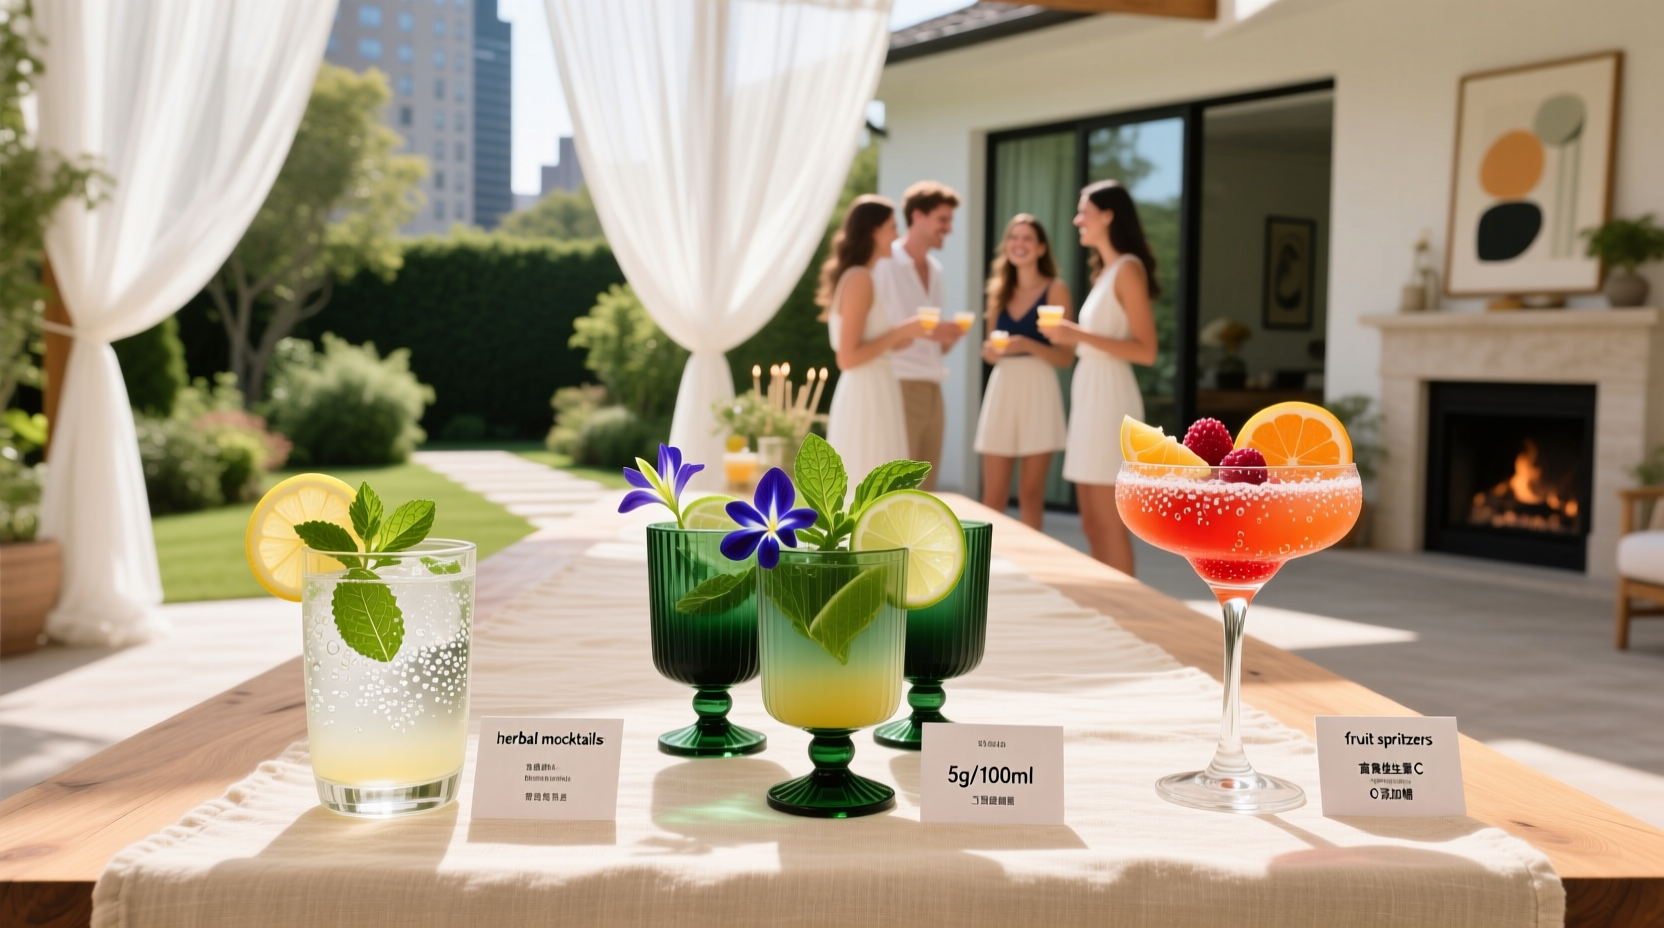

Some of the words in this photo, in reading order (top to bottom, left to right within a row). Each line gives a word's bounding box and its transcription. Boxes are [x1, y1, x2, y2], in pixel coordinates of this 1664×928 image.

[496, 730, 539, 745] herbal
[541, 731, 604, 746] mocktails
[1344, 731, 1375, 745] fruit
[1377, 732, 1433, 749] spritzers
[948, 764, 1033, 788] 5g/100ml
